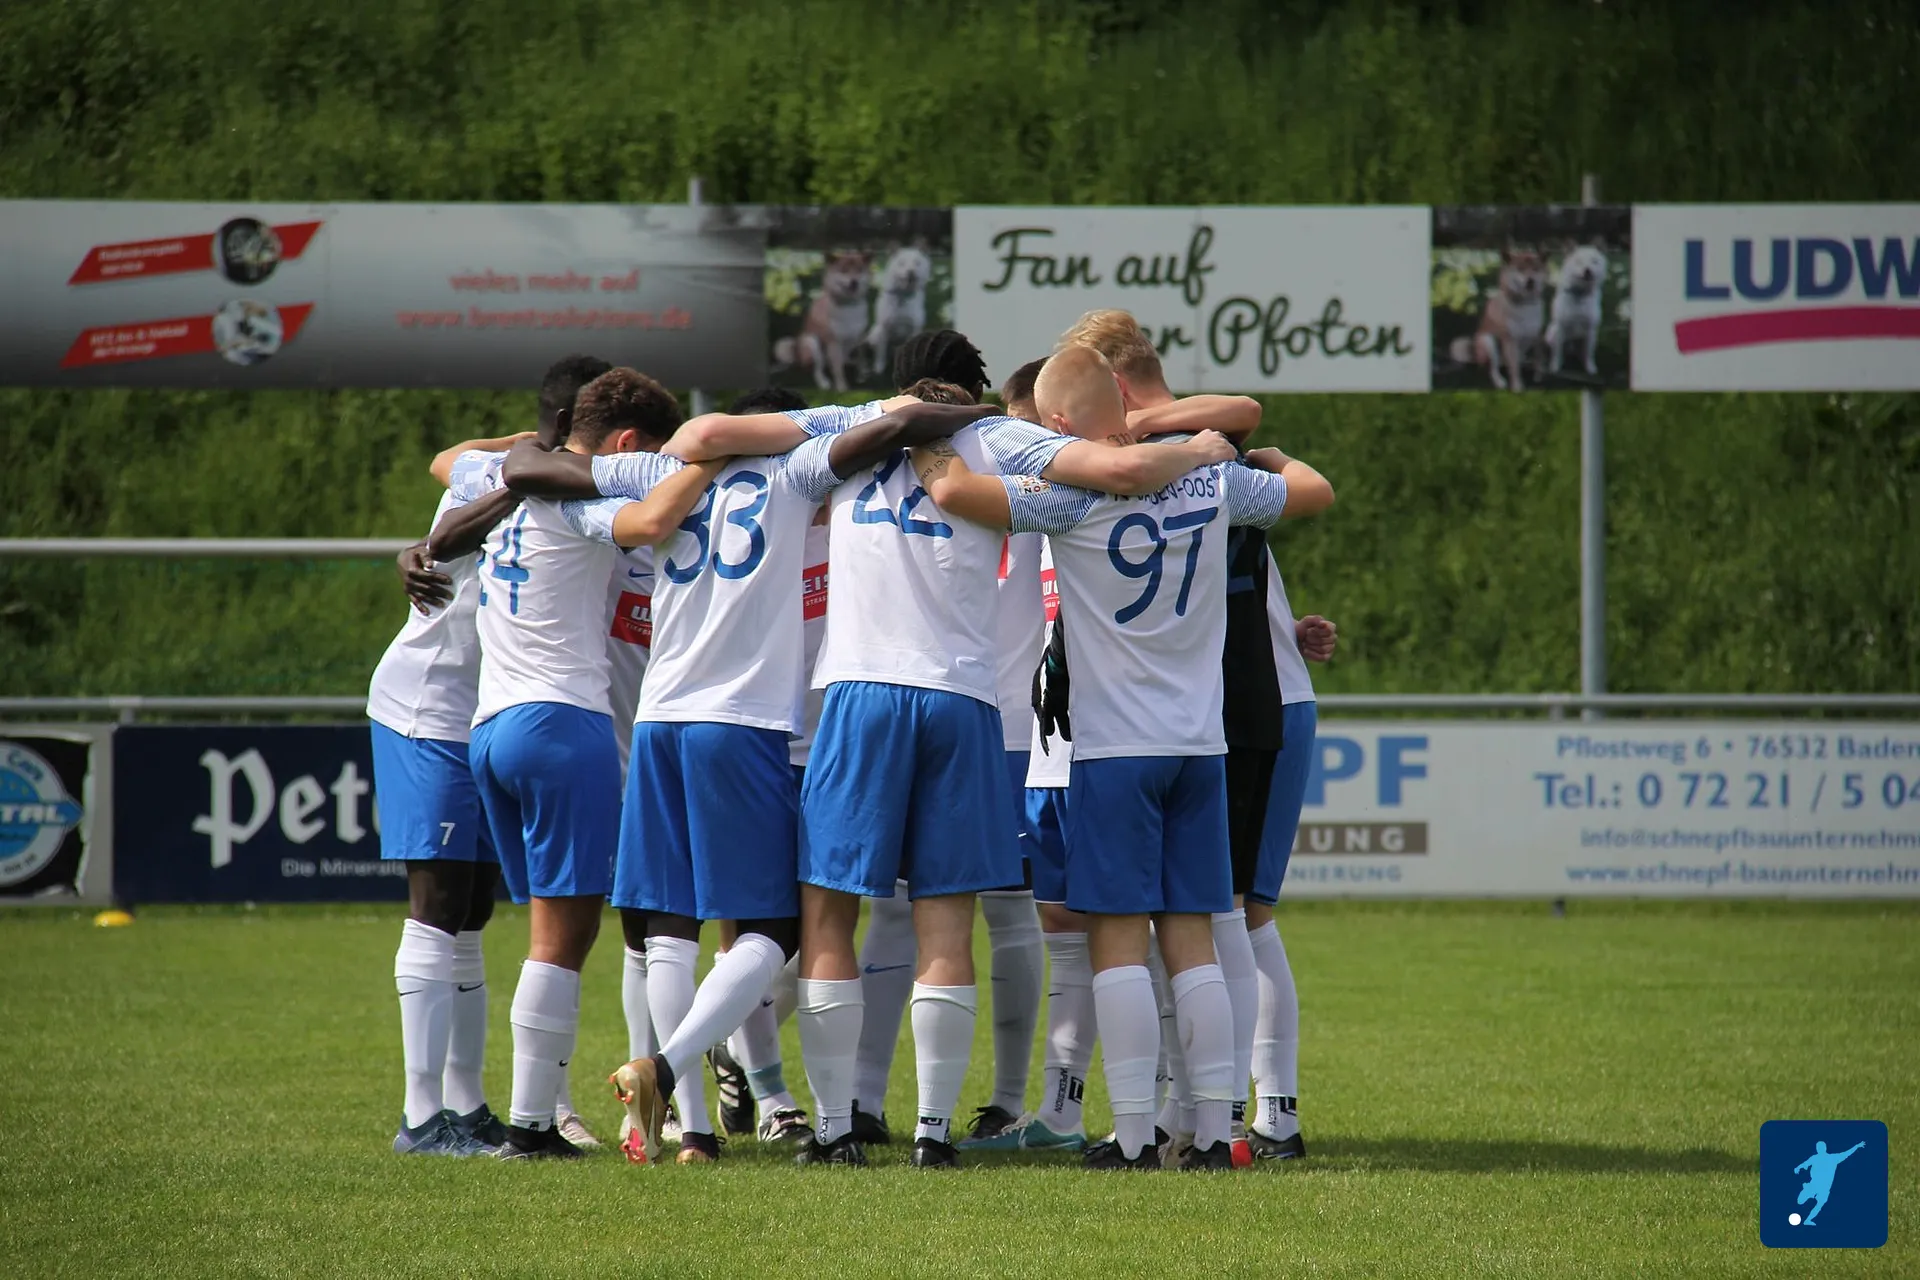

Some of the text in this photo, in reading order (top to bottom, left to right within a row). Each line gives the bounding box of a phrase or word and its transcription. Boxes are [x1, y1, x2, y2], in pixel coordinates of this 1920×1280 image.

[982, 225, 1214, 306] Fan auf
[1685, 238, 1920, 300] LUDW
[1209, 297, 1413, 377] Pfoten
[476, 508, 529, 615] 4
[664, 470, 769, 584] 33
[1108, 507, 1218, 624] 97
[1695, 735, 1712, 759] 6
[1748, 734, 1828, 759] 76532
[191, 747, 380, 869] Pet
[1534, 773, 1621, 808] Tel.:
[1638, 772, 1662, 808] 0
[1842, 773, 1864, 808] 5
[281, 859, 316, 877] Die
[440, 822, 455, 845] 7
[1291, 826, 1405, 852] UNG
